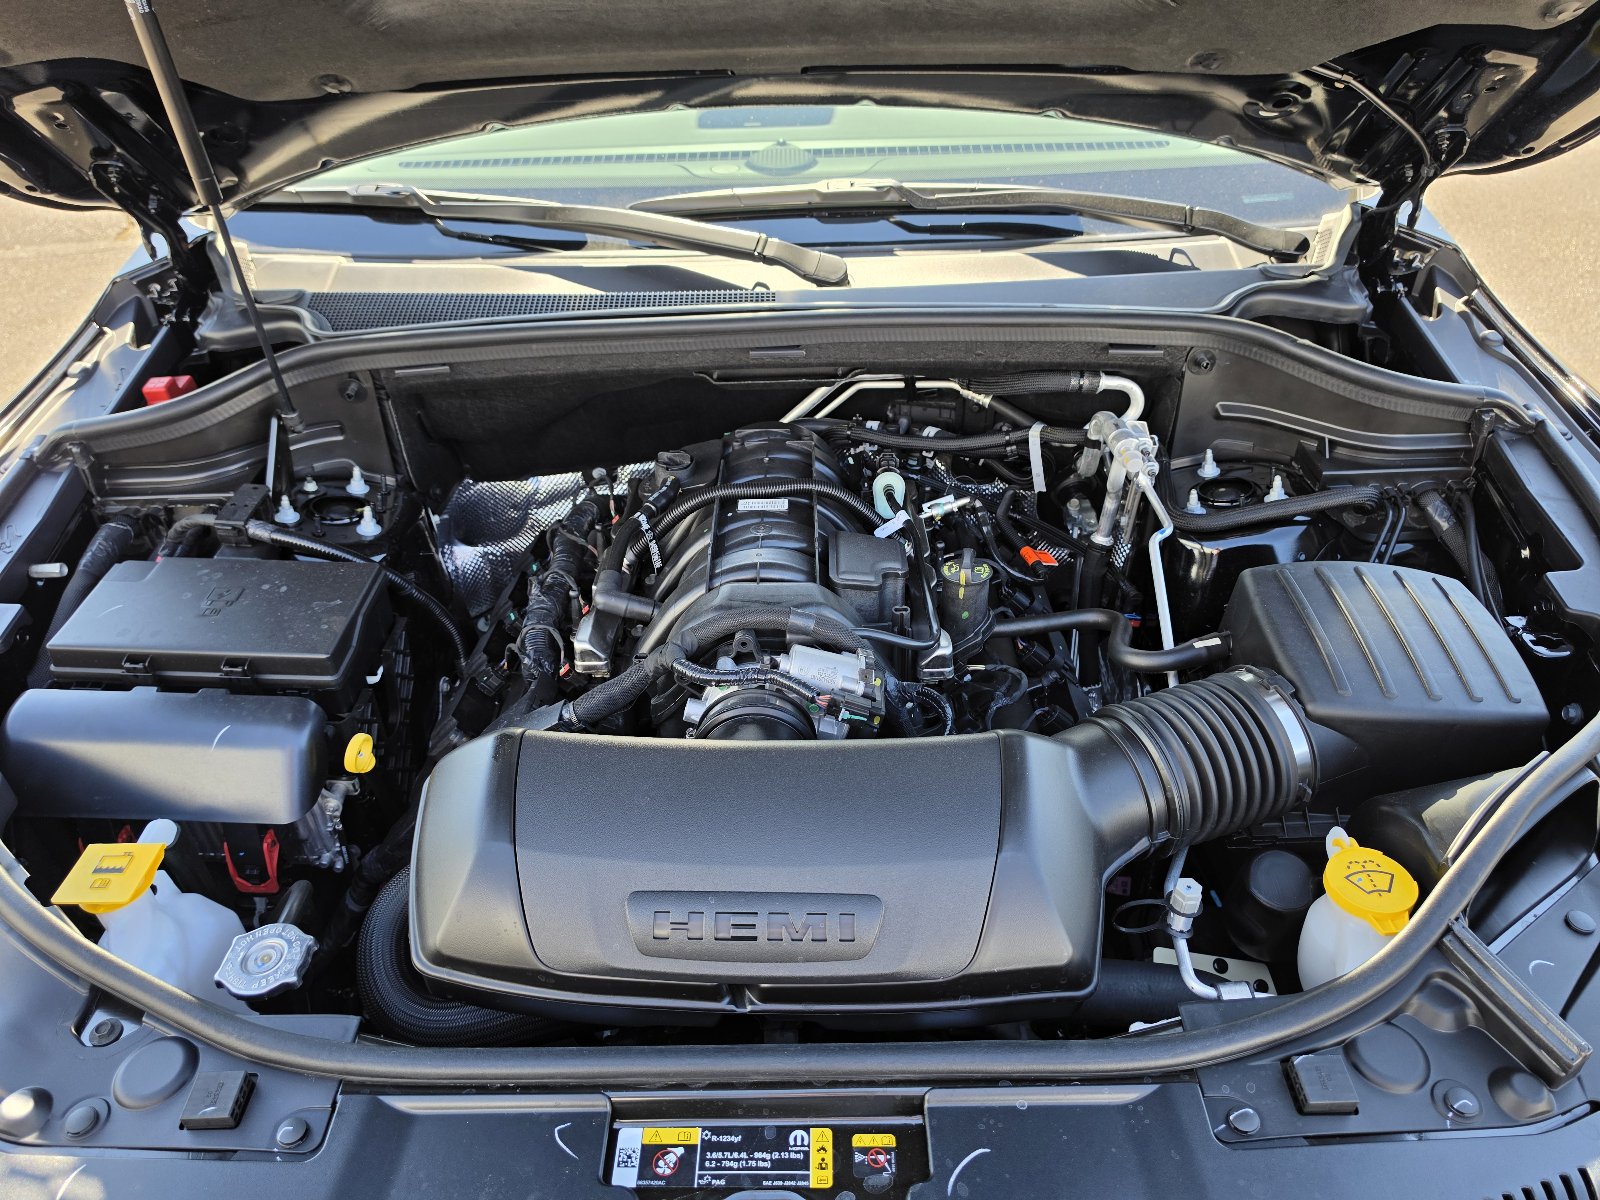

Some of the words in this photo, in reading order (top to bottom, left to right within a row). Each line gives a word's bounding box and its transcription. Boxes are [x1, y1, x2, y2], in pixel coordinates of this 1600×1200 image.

[653, 911, 856, 942] HEMI
[255, 927, 283, 938] OPEN
[711, 1135, 742, 1143] R-1234yf
[772, 1152, 789, 1160] (2.13
[790, 1152, 804, 1160] lbs)
[739, 1160, 757, 1168] (1.75
[757, 1160, 771, 1168] lbs)
